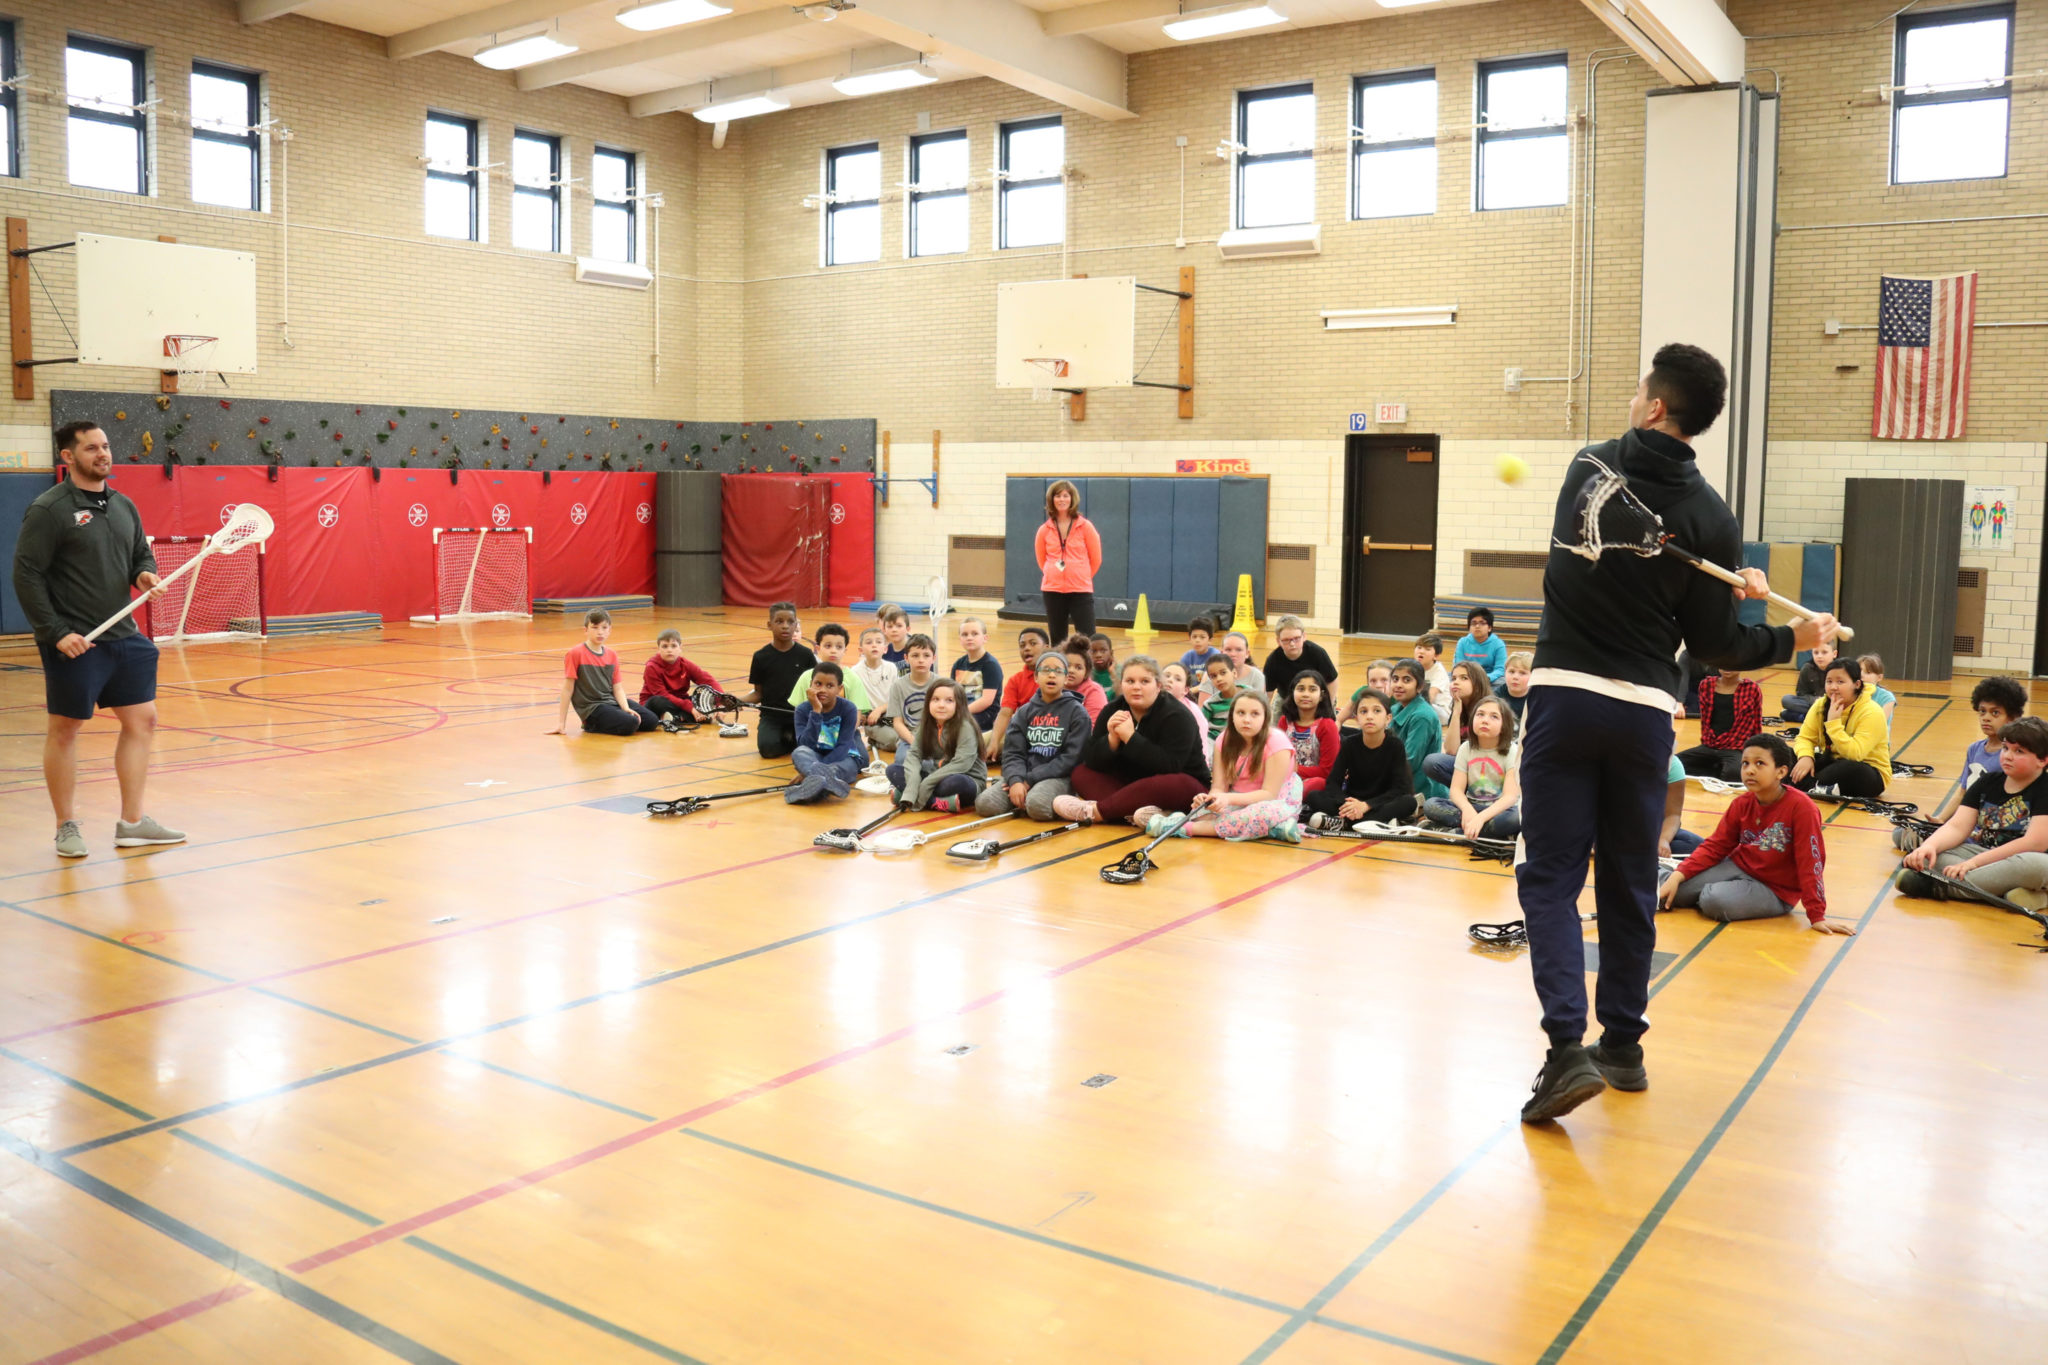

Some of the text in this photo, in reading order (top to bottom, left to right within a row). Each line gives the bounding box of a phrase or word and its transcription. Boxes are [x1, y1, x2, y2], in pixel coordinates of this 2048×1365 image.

[1381, 405, 1400, 421] EXIT
[1351, 415, 1365, 430] 19
[1196, 460, 1248, 473] Kind
